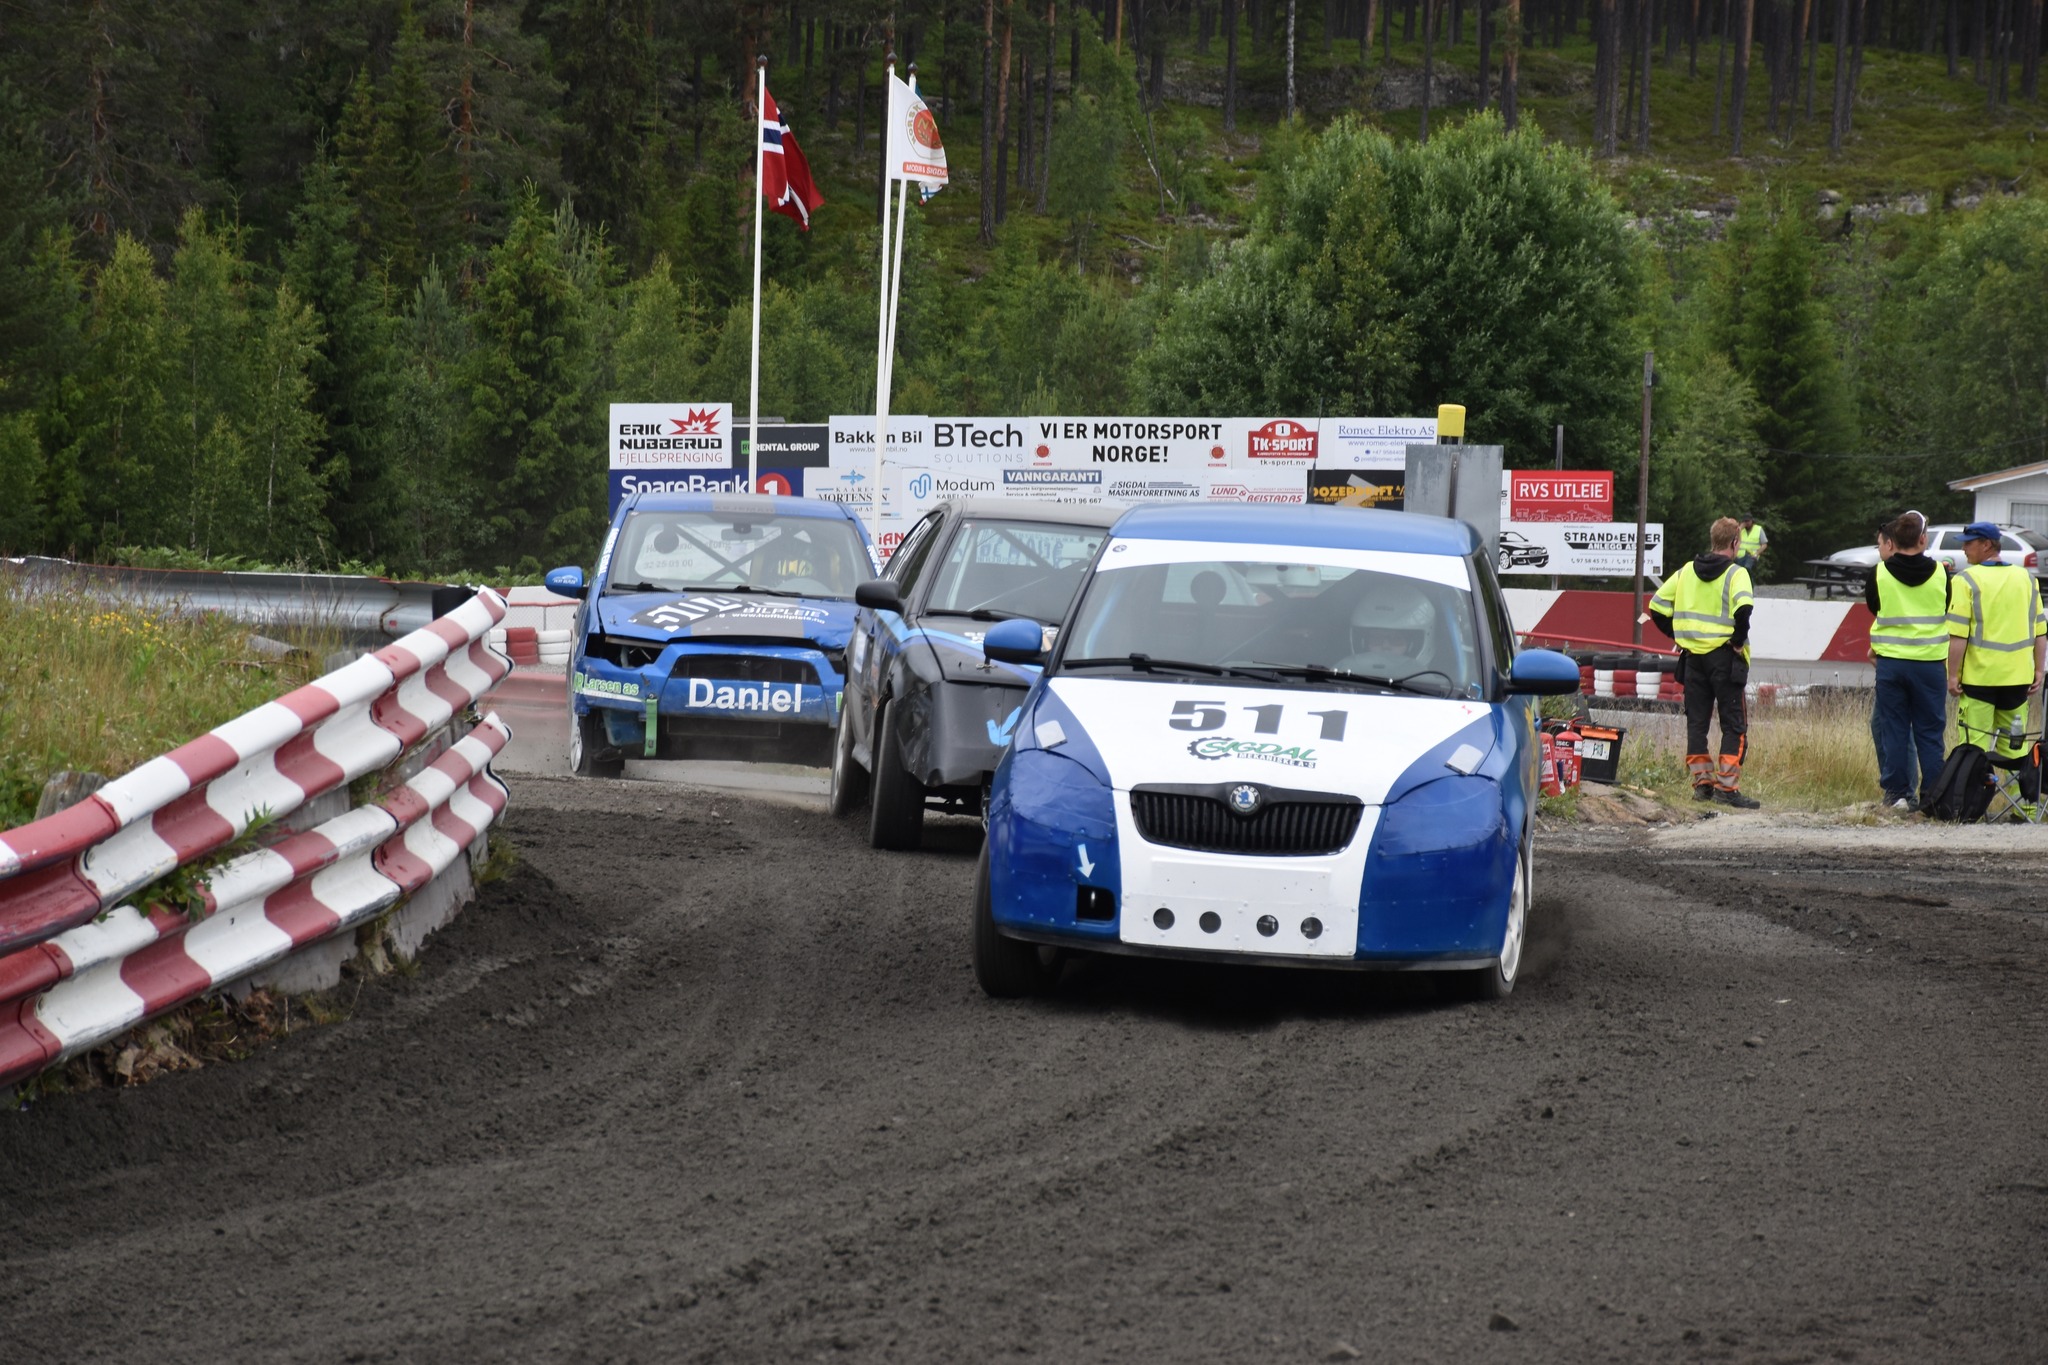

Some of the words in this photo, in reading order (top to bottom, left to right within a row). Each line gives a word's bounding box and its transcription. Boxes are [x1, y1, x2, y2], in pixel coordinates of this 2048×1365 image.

[620, 424, 662, 435] ERIK
[1040, 423, 1057, 438] VI
[1064, 424, 1087, 439] ER
[1094, 424, 1222, 440] MOTORSPORT
[1339, 426, 1375, 435] Romec
[1379, 426, 1416, 435] Elektro
[1420, 426, 1435, 435] AS
[835, 431, 896, 443] Bakkn
[902, 431, 922, 443] Bil
[934, 424, 1023, 447] BTech
[620, 438, 722, 449] NUBBERUD
[757, 443, 789, 452] RENTAL
[790, 443, 820, 451] GROUP
[619, 453, 723, 465] FJELLSPRENGING
[934, 454, 1023, 463] SOLUTIONS
[1092, 445, 1168, 462] NORGE!
[1007, 472, 1099, 482] VANNGARANTI
[765, 480, 778, 495] 1
[937, 479, 995, 490] Modum
[1108, 489, 1187, 497] MASKINFORRETNING
[1519, 483, 1549, 498] RVS
[1554, 483, 1604, 498] UTLEIE
[819, 494, 888, 503] MORTENSN
[1247, 495, 1288, 503] REISTAD
[1288, 495, 1303, 503] AS
[1588, 543, 1622, 551] ANLEGG
[584, 674, 622, 694] Larsen
[623, 683, 640, 695] as
[690, 678, 802, 713] Daniel
[1168, 700, 1348, 742] 511
[1200, 741, 1318, 761] SIGDAL
